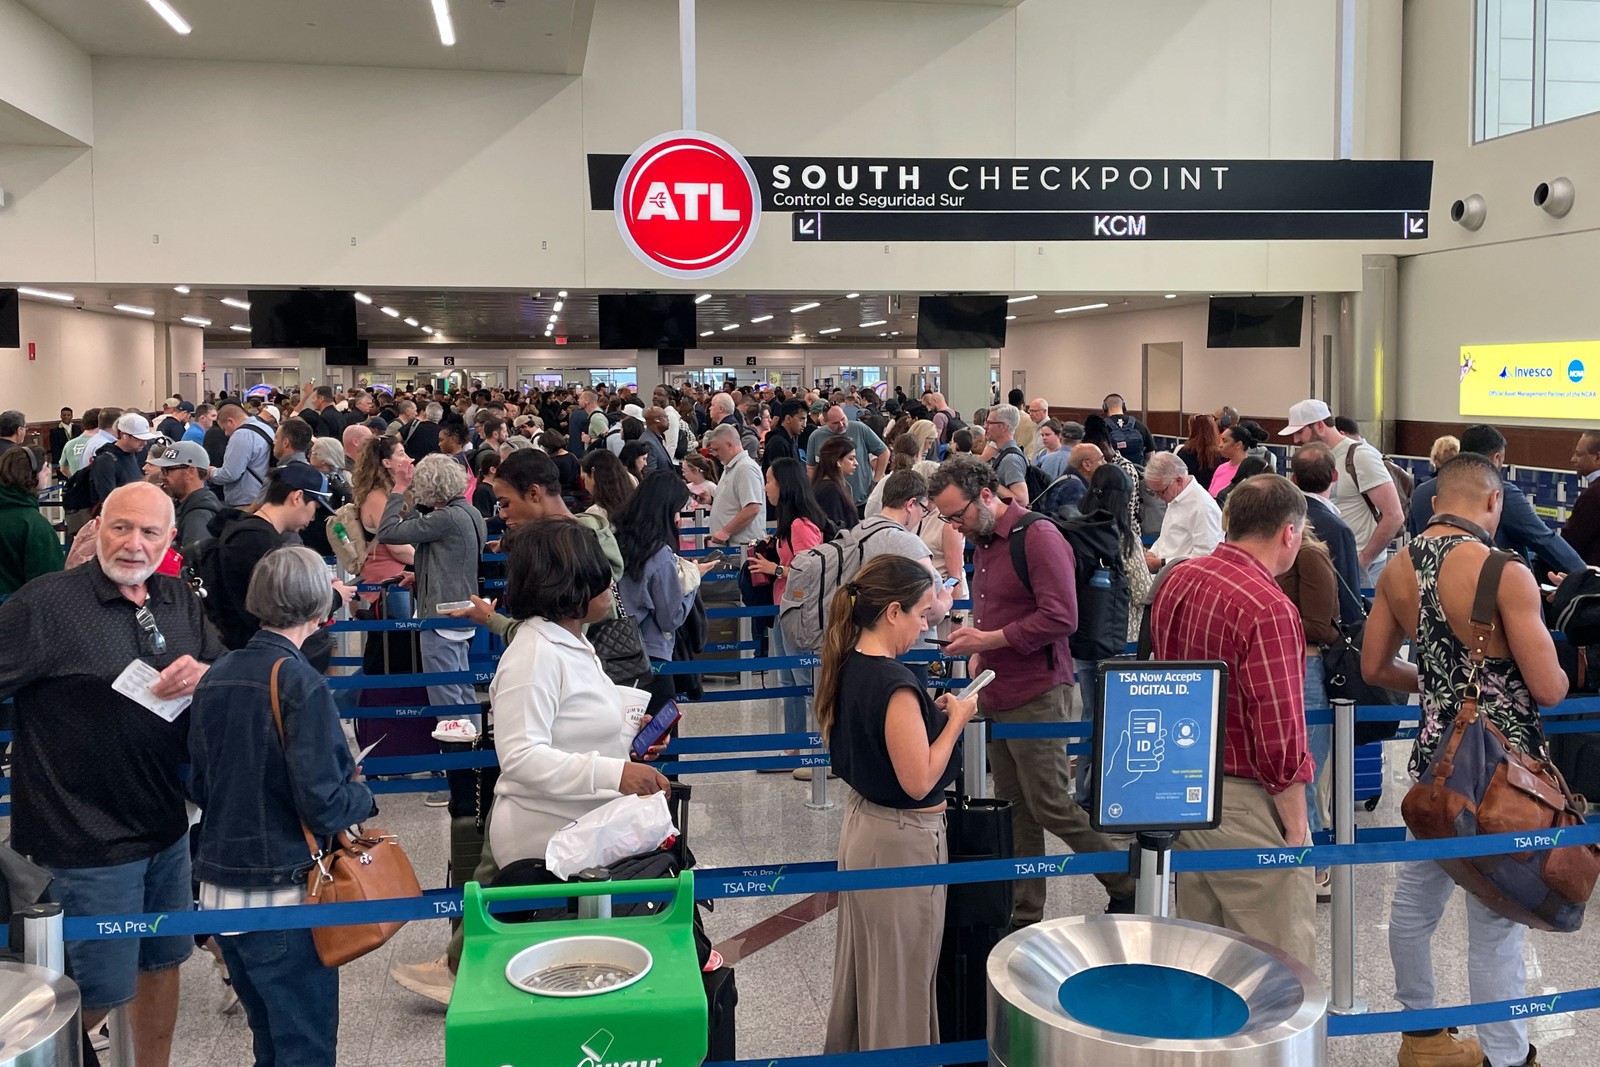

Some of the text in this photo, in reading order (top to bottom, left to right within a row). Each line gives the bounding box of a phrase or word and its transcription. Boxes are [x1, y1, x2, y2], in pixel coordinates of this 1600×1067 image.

[772, 164, 1230, 191] SOUTH CHECKPOINT
[636, 181, 740, 221] ATL
[773, 193, 965, 208] Control de Seguridad Sur
[1094, 215, 1147, 236] KCM
[410, 357, 416, 365] 7
[446, 357, 452, 365] 6
[715, 357, 721, 365] 5
[748, 357, 754, 365] 4
[1514, 366, 1553, 377] Invesco
[1119, 672, 1202, 683] TSA Now Accepts
[1130, 684, 1189, 695] DIGITAL ID.
[1136, 740, 1151, 752] ID
[1514, 835, 1550, 848] TSA Pre
[1257, 853, 1295, 864] TSA Pre
[1014, 862, 1056, 875] TSA Pre
[723, 881, 766, 894] TSA Pre
[433, 901, 457, 914] TSA
[96, 921, 147, 935] TSA Pre
[1510, 1002, 1546, 1016] TSA Pre
